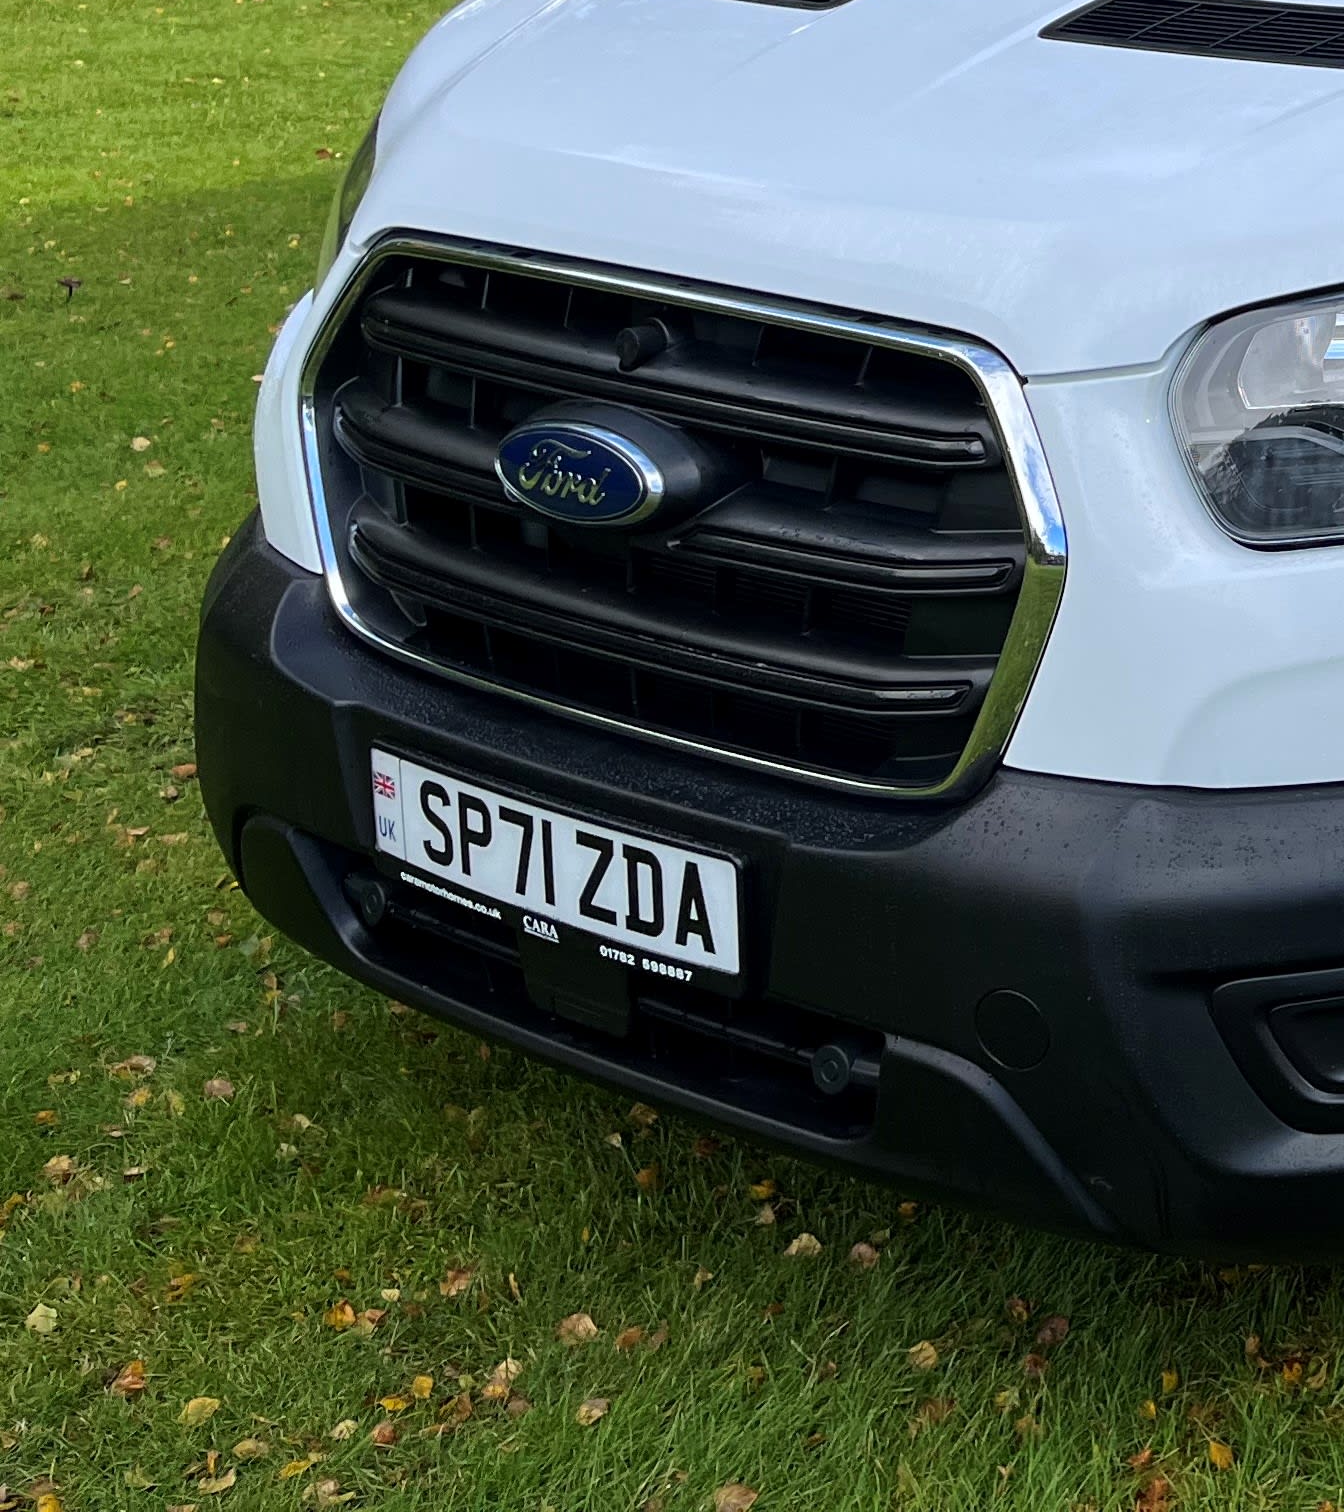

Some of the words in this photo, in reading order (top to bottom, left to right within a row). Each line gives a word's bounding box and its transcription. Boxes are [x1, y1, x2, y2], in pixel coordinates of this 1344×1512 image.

[518, 438, 612, 506] Ford
[378, 815, 397, 842] UK
[419, 779, 556, 907] SP71
[575, 829, 717, 956] ZDA
[522, 914, 560, 940] CARA
[599, 944, 636, 966] 01782
